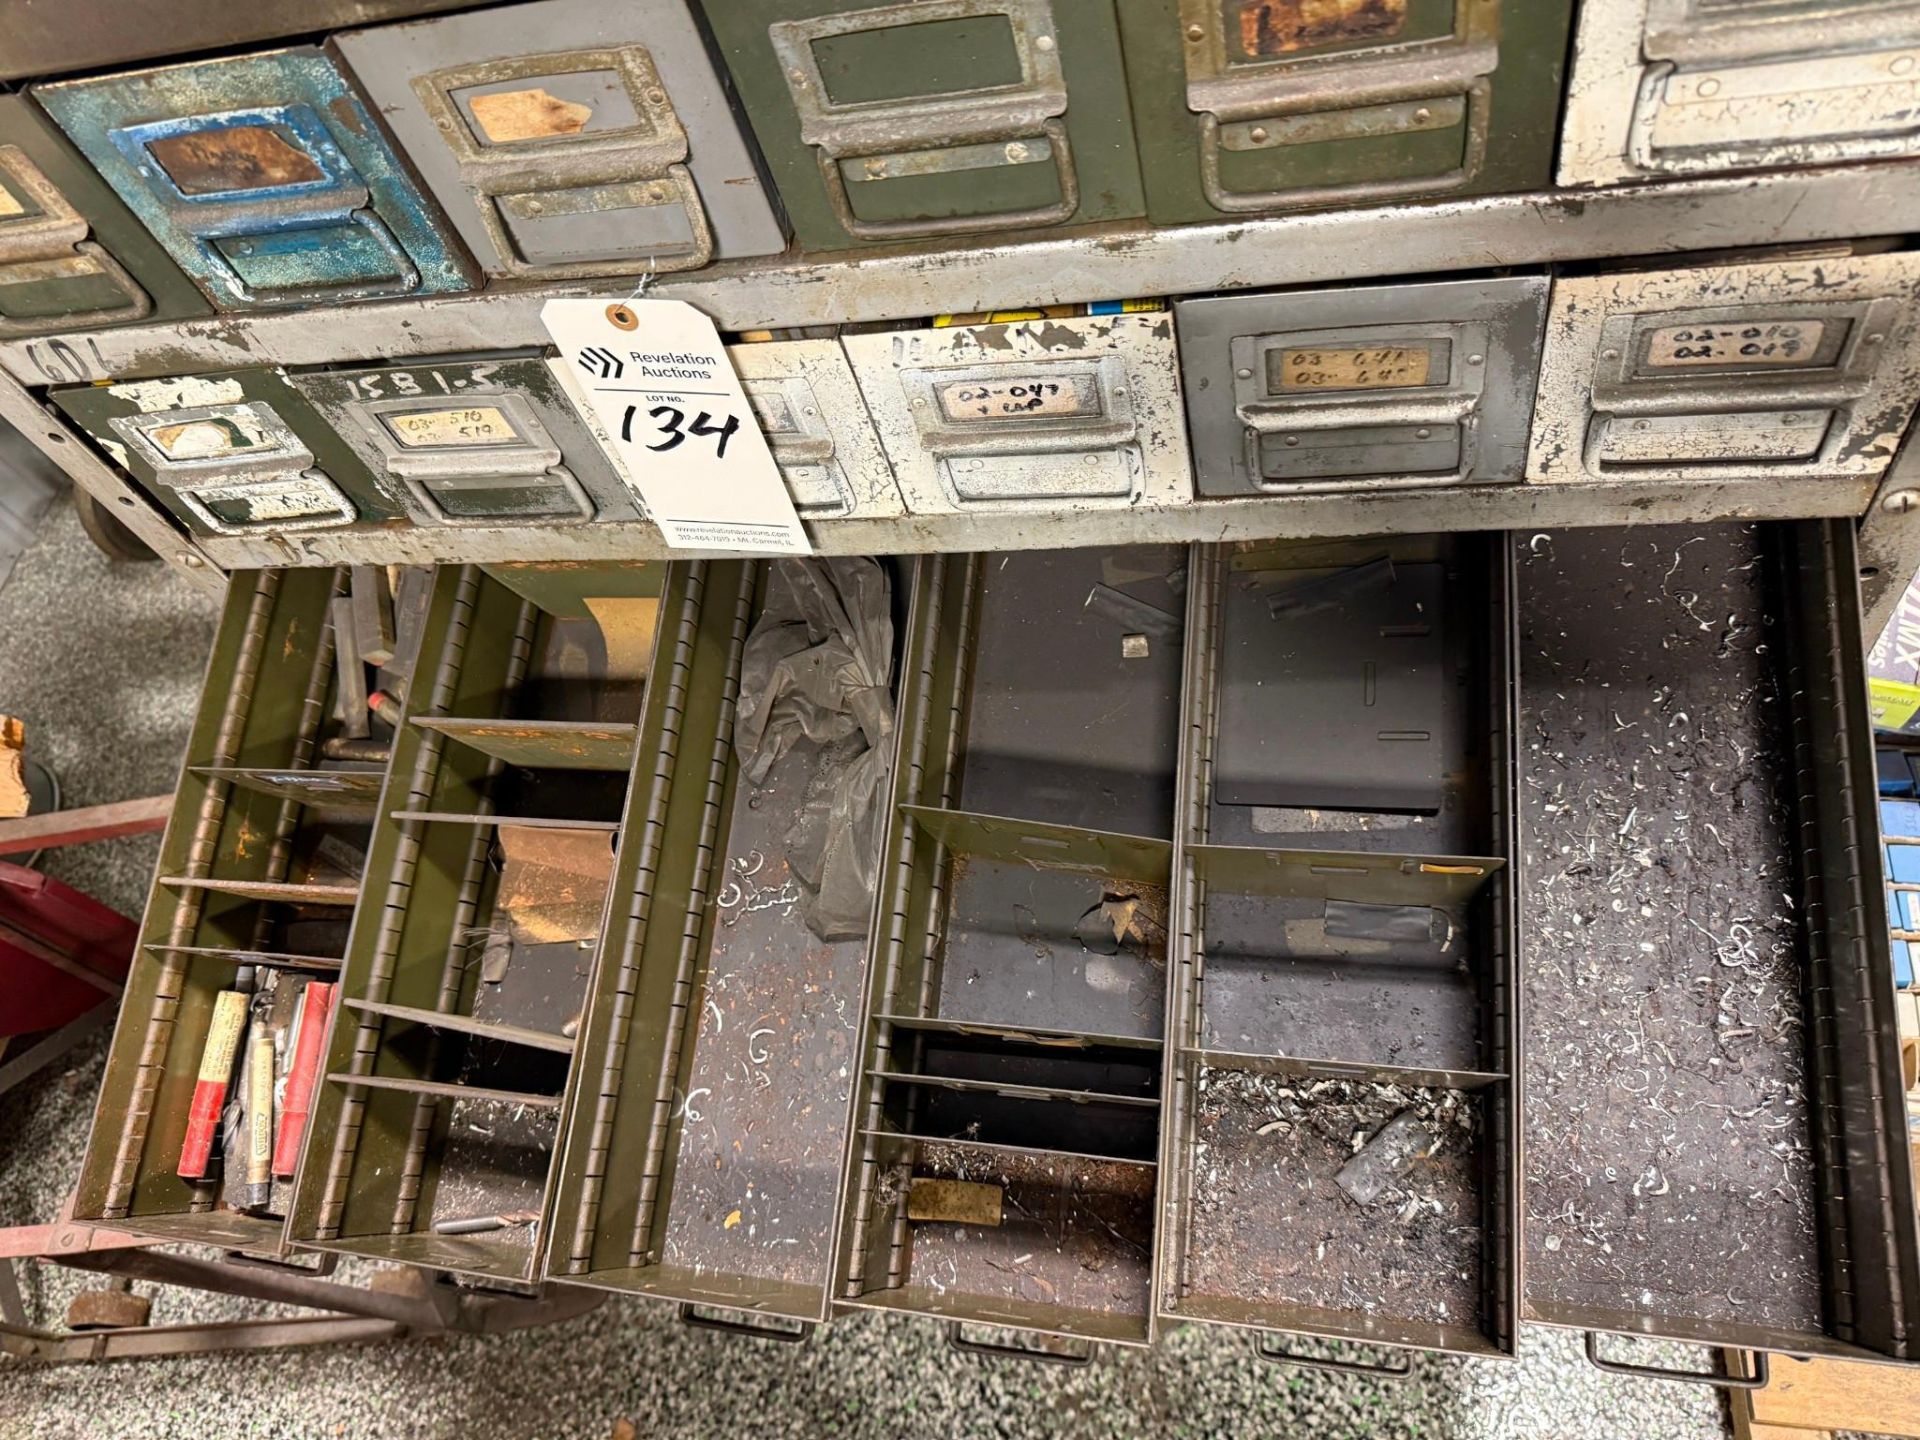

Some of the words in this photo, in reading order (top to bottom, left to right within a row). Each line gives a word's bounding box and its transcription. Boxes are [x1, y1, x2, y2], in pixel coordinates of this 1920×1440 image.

[630, 351, 716, 367] Revelation
[641, 366, 712, 380] Auctions
[646, 395, 665, 404] LOT
[666, 396, 685, 404] NO.
[622, 405, 739, 459] 134
[675, 526, 790, 538] www.revelationauctions.com
